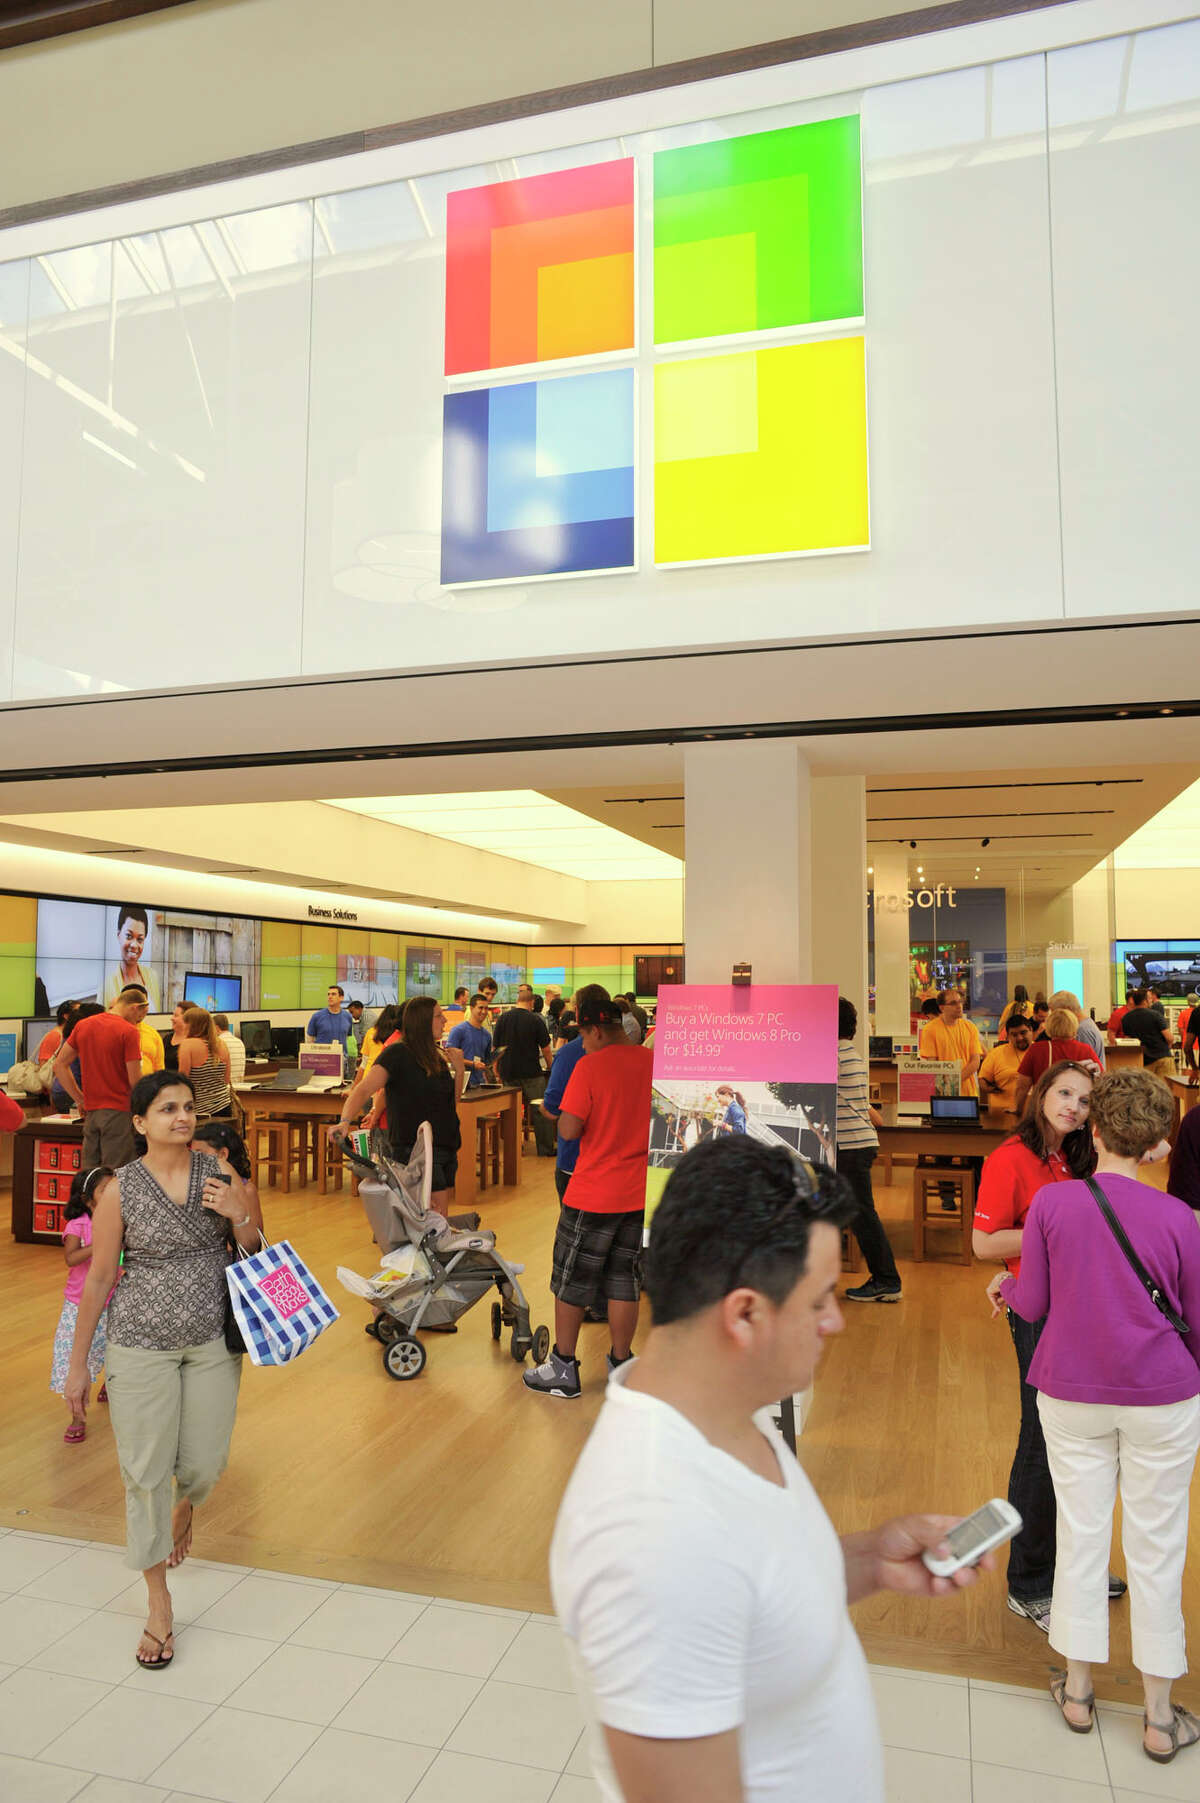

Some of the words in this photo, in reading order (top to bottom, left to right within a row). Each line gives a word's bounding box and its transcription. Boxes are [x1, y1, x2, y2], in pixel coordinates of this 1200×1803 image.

[308, 904, 332, 918] Business
[332, 908, 358, 921] Solutions
[665, 1011, 687, 1028] Buy
[689, 1015, 697, 1025] a
[699, 1012, 755, 1025] Windows
[757, 1012, 764, 1025] 7
[767, 1012, 784, 1025] PC
[664, 1028, 687, 1041] and
[689, 1030, 709, 1044] get
[711, 1028, 767, 1041] Windows
[769, 1028, 778, 1041] 8
[781, 1028, 801, 1042] Pro
[664, 1043, 680, 1057] for
[260, 1271, 297, 1298] Bath
